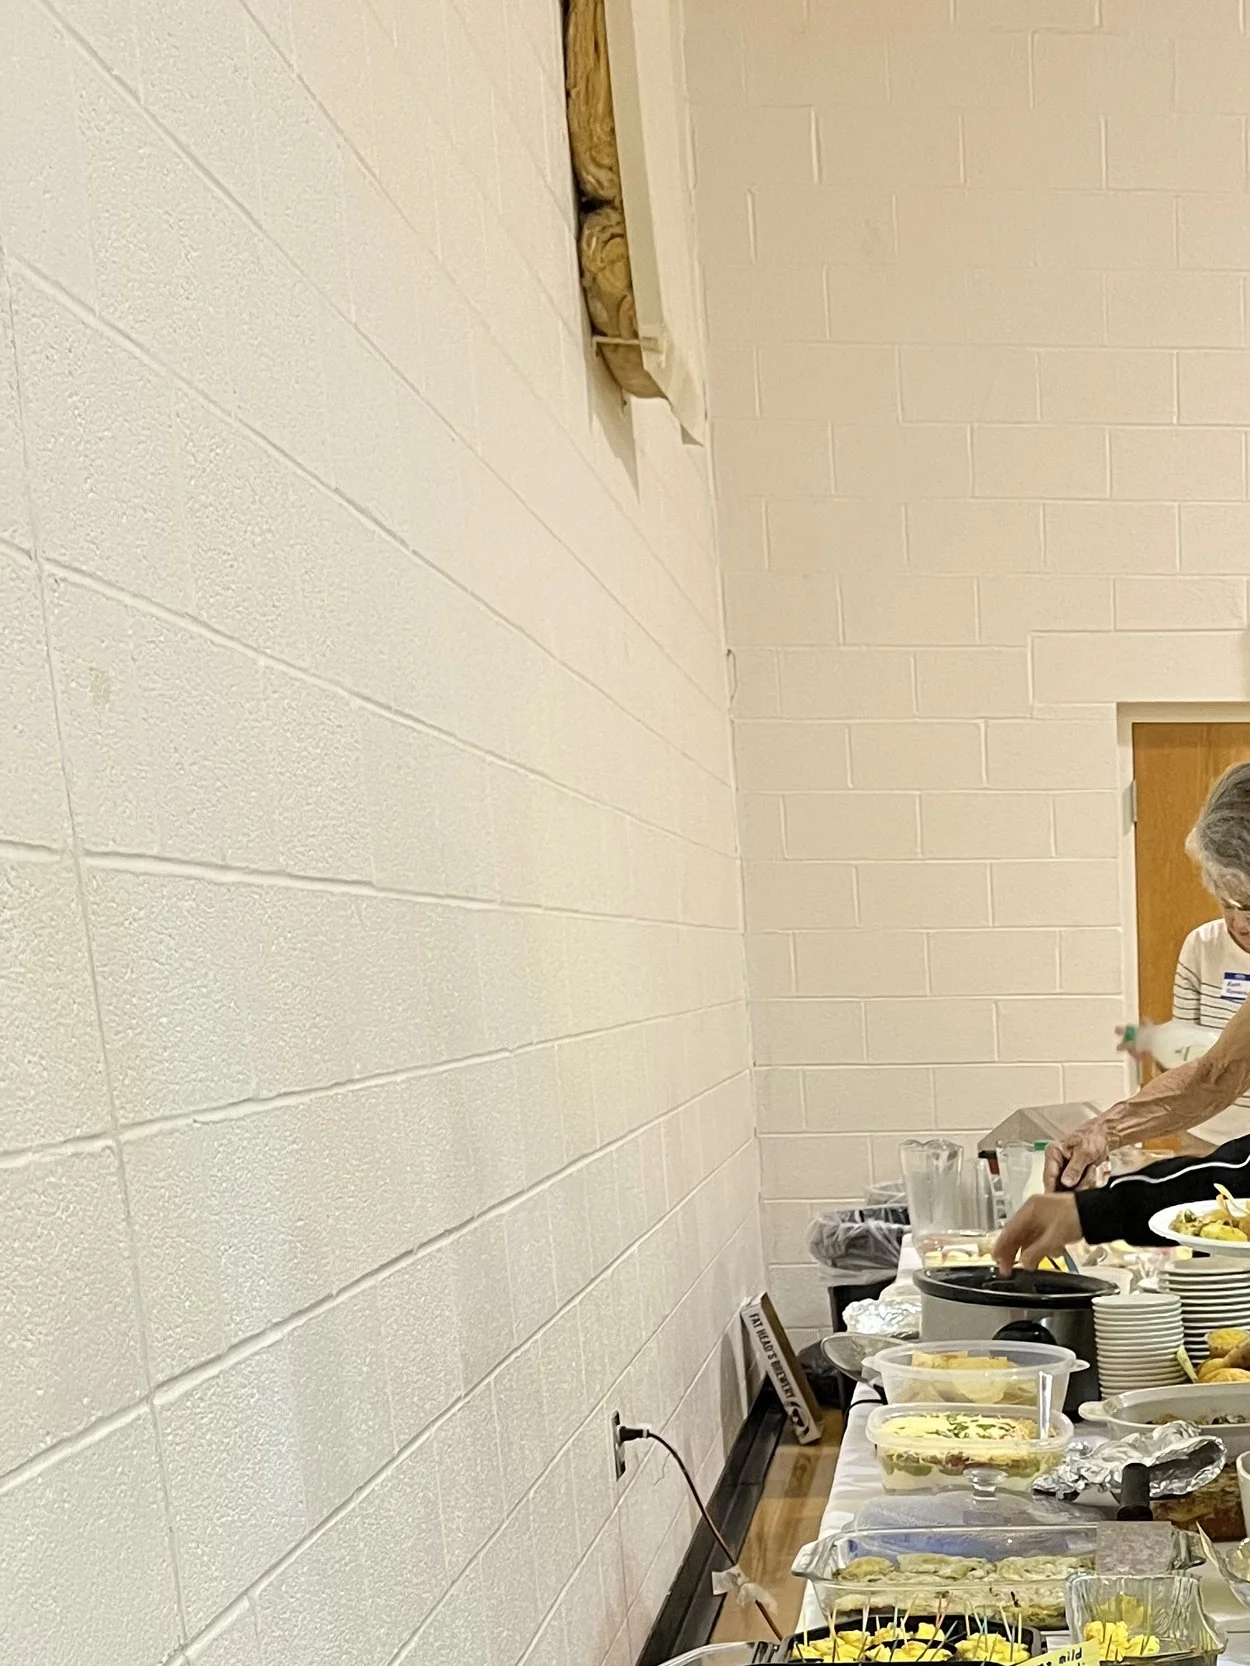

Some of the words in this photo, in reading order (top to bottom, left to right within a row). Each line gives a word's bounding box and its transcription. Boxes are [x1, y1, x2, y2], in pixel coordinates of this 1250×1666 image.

[749, 1312, 764, 1329] FAT
[756, 1328, 778, 1360] HEAD'S
[771, 1360, 796, 1399] BREWERY
[1058, 1646, 1082, 1664] mild
